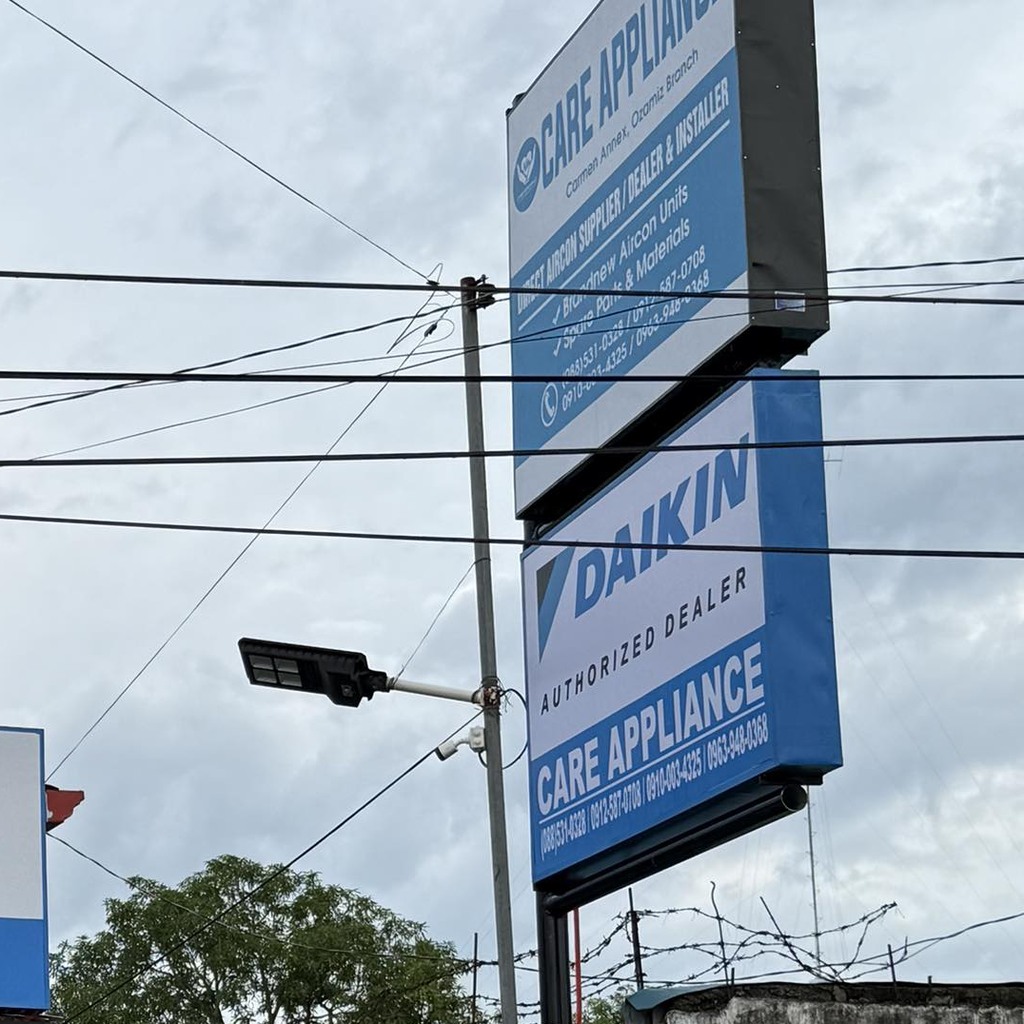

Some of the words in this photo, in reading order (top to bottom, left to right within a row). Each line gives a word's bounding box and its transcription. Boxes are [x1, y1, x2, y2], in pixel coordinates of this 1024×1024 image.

[539, 66, 594, 189] CARE
[599, 0, 719, 129] APPLIAN
[565, 157, 599, 199] Carmen
[600, 127, 630, 164] Annex,
[631, 86, 665, 129] Ozamiz
[666, 48, 699, 92] Branch
[517, 263, 545, 315] DIRECT
[546, 233, 577, 287] AIRCON
[578, 186, 622, 252] SUPPLIER
[628, 143, 664, 203] DEALER
[665, 134, 675, 165] &
[675, 76, 730, 156] INSTALLER
[563, 254, 617, 319] Brandnew
[619, 215, 657, 265] Aircon
[659, 183, 689, 225] Units
[563, 310, 594, 349] Spare
[596, 281, 623, 318] Parts
[625, 267, 634, 292] &
[636, 218, 690, 282] Materials
[574, 432, 750, 619] DAIKIN
[540, 626, 655, 716] AUTHORIZED
[664, 566, 747, 639] DEALER
[536, 736, 601, 816] CARE
[607, 641, 766, 781] APPLIANCE
